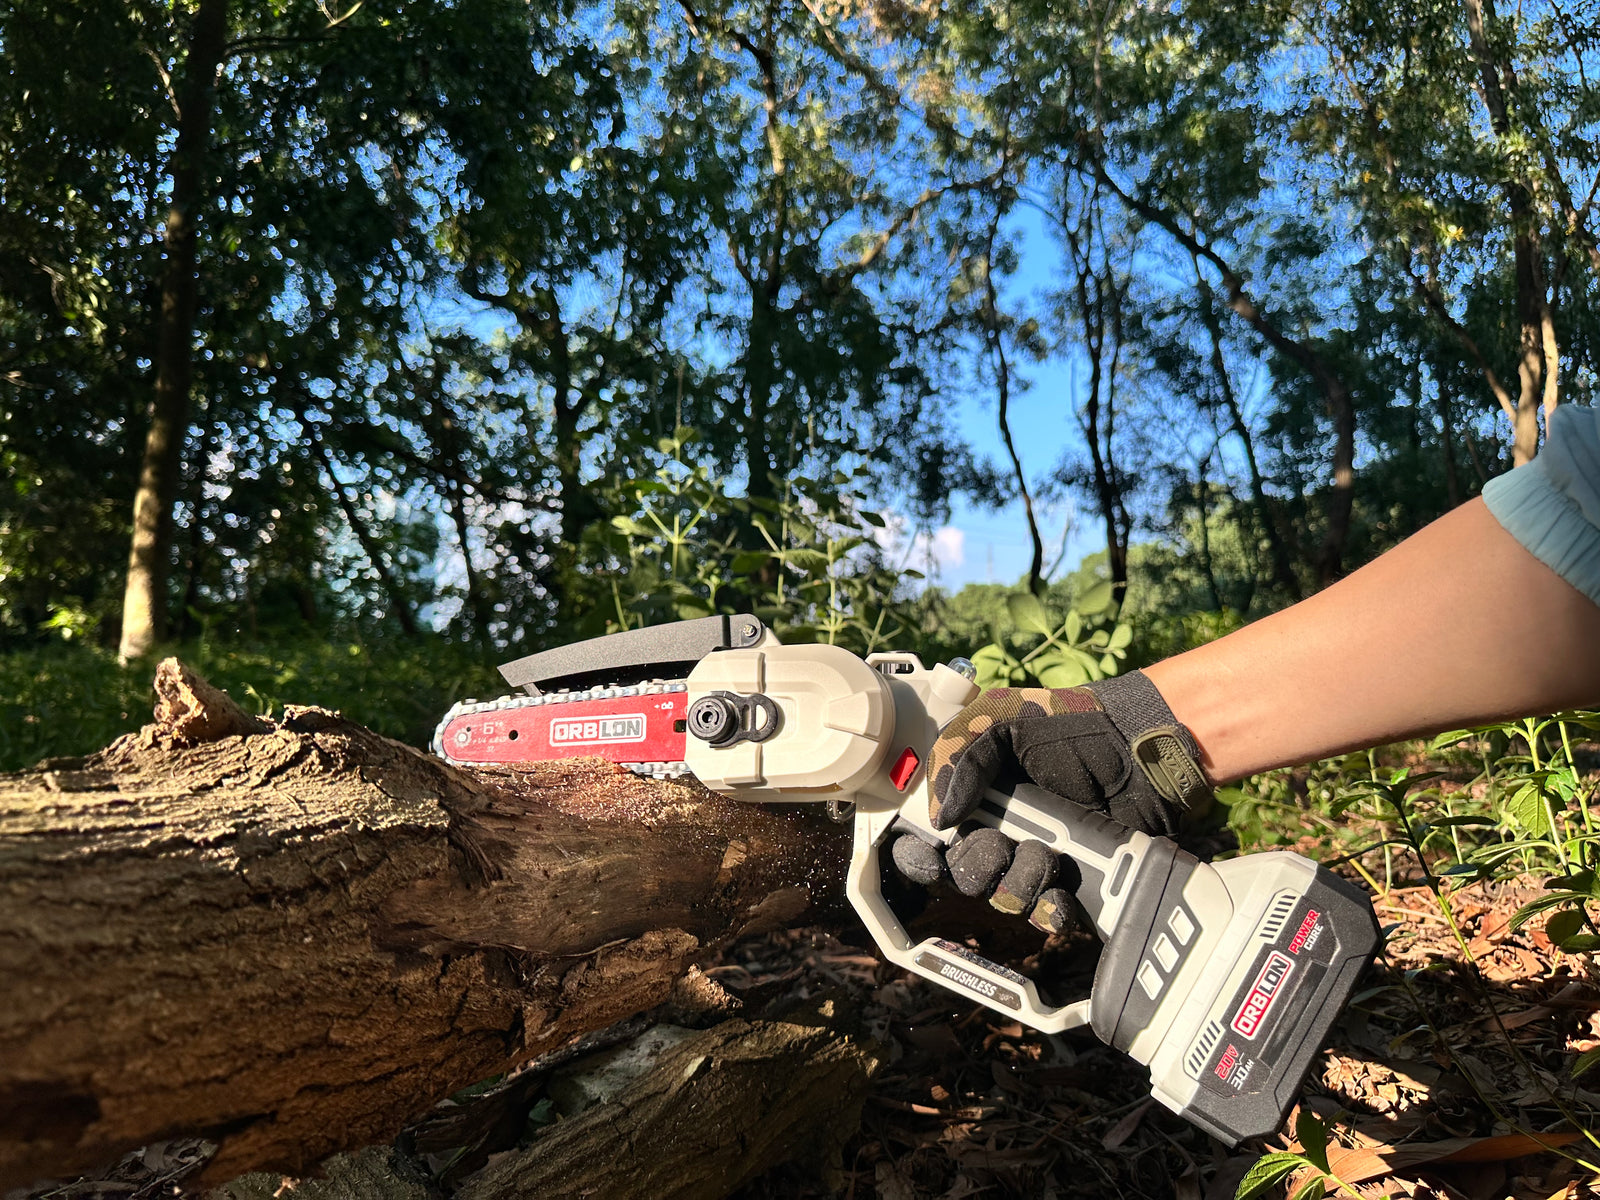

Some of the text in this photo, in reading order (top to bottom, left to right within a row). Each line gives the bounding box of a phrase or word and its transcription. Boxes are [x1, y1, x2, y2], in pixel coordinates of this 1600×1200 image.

[554, 719, 641, 741] ORBLON
[1288, 909, 1320, 955] POWER
[1303, 923, 1323, 951] CORE
[940, 963, 997, 997] BRUSHLESS
[1237, 958, 1288, 1034] ORBLON
[1213, 1043, 1239, 1080] 20V
